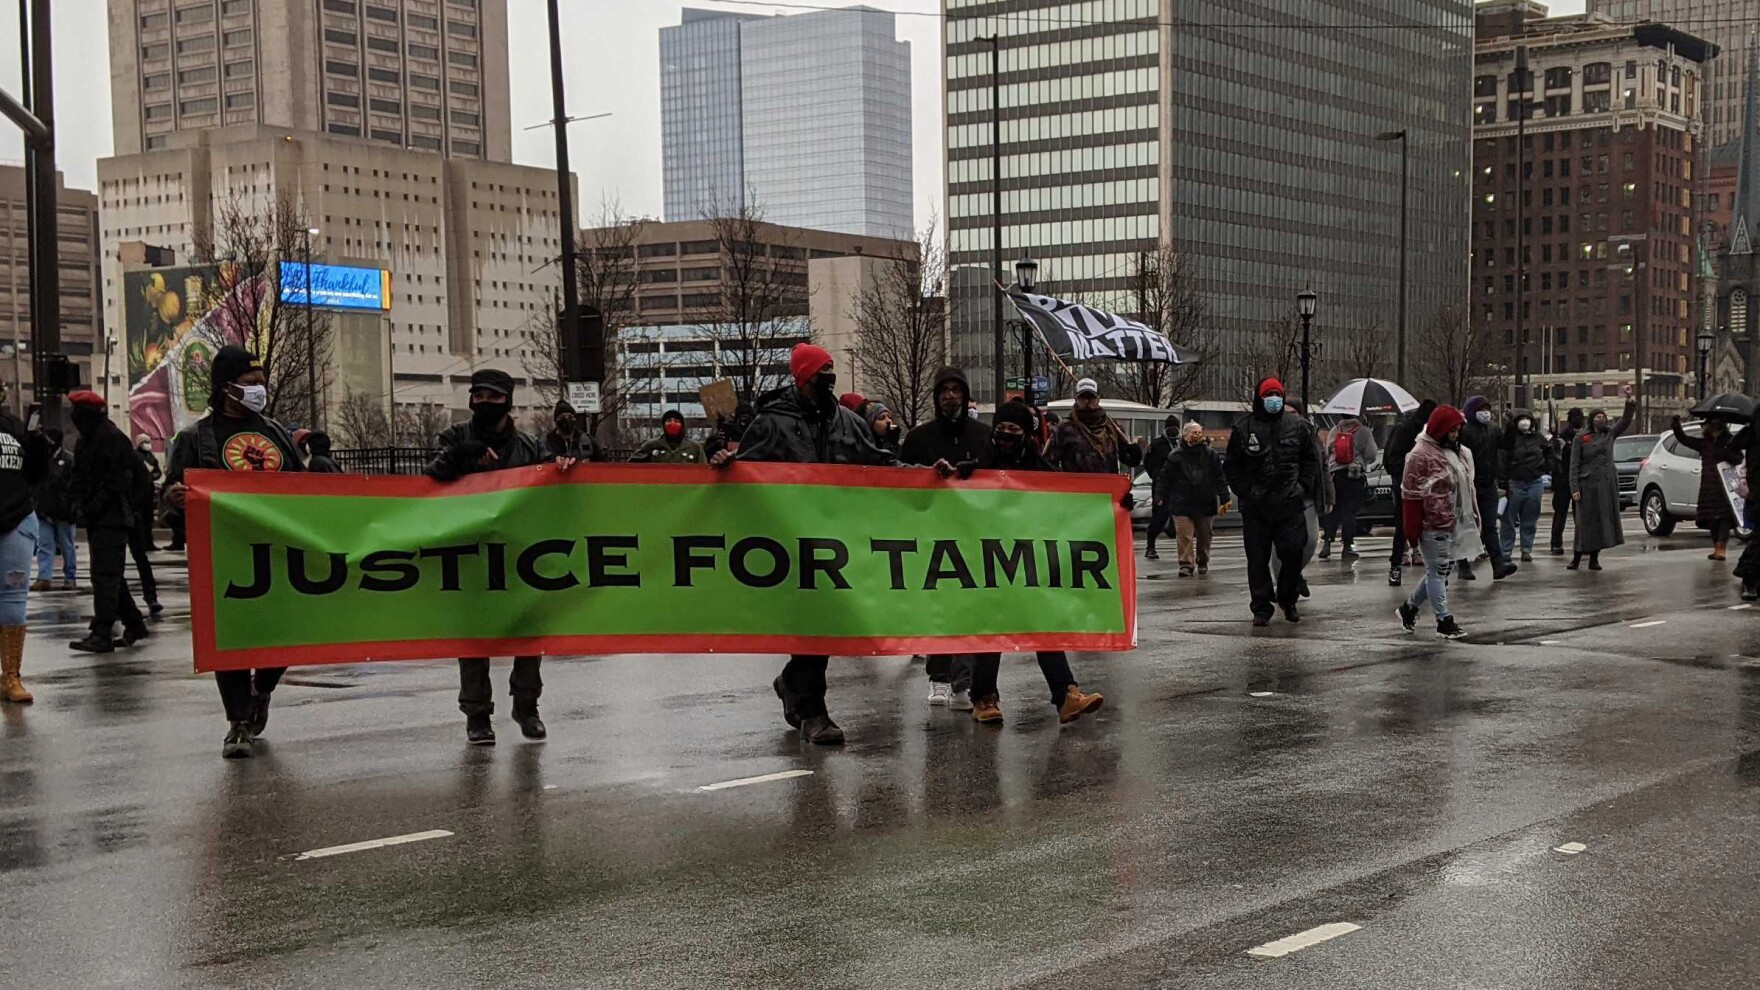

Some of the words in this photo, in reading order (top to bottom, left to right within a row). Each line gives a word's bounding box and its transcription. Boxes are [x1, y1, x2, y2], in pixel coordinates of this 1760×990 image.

[312, 268, 370, 294] Thankful
[1066, 329, 1183, 364] MATTER
[0, 455, 23, 470] KEN
[1, 445, 18, 455] NOT
[224, 534, 641, 599] JUSTICE
[671, 533, 853, 590] FOR
[870, 537, 1113, 590] TAMIR
